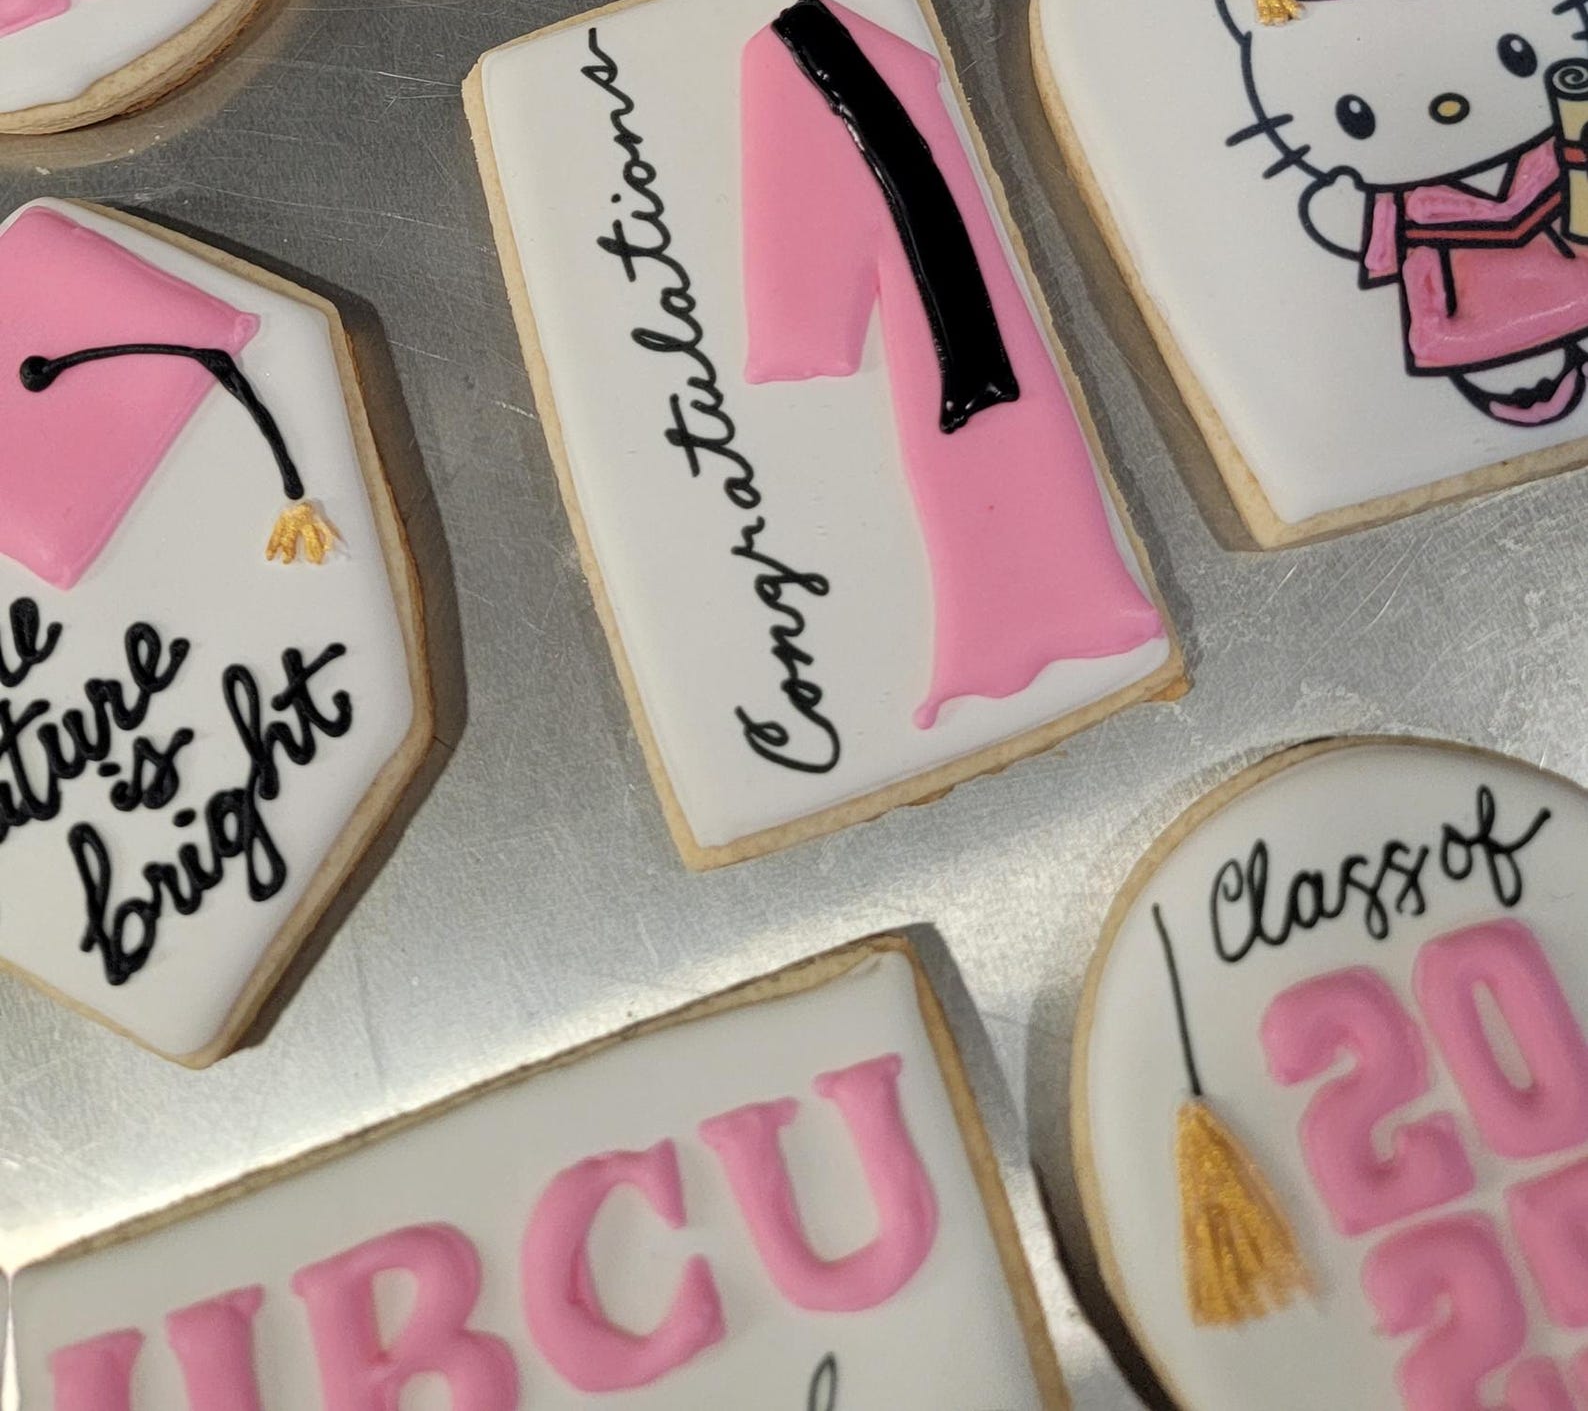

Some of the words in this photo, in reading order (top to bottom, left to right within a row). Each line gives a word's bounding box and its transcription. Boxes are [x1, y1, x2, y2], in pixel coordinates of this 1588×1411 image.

[581, 26, 840, 775] Congratulations
[67, 642, 352, 987] bright
[97, 727, 195, 812] is
[1209, 839, 1429, 963] Class
[1440, 784, 1551, 908] of
[1258, 916, 1588, 1239] 20
